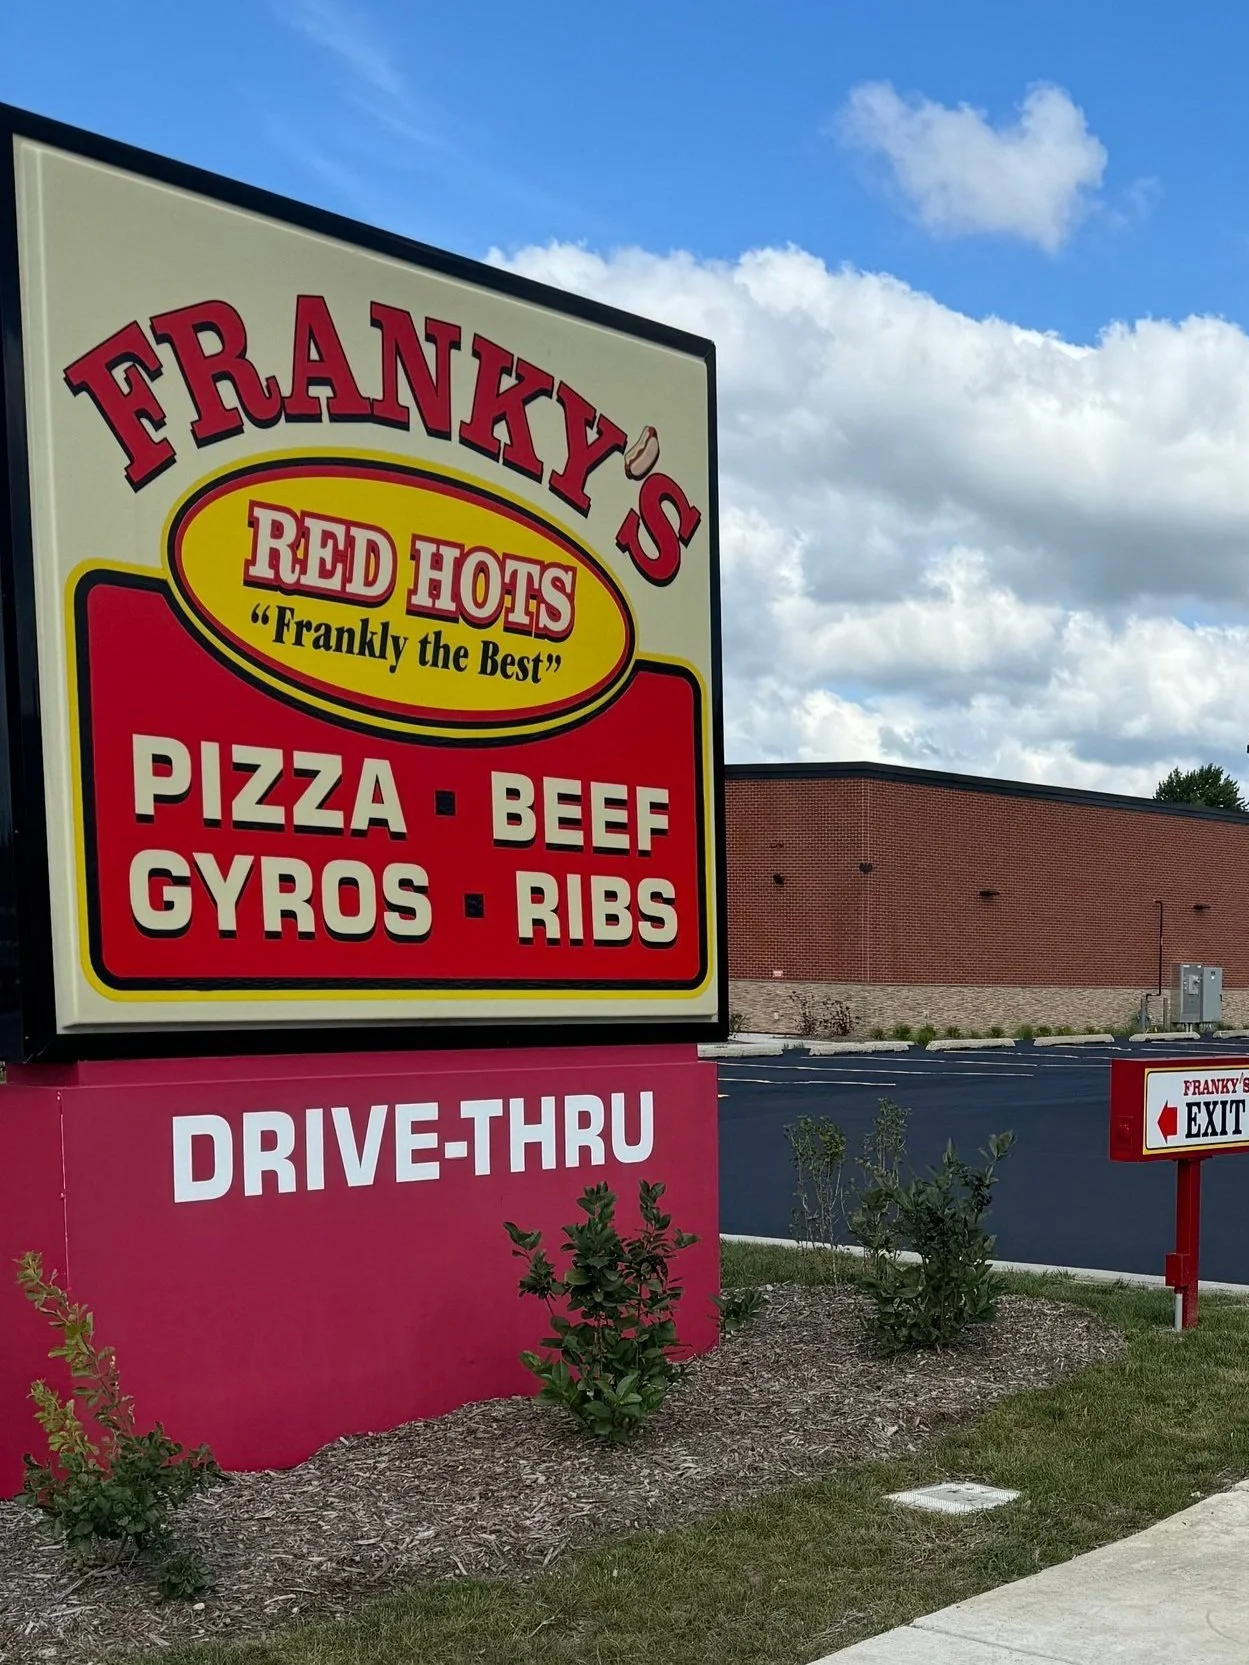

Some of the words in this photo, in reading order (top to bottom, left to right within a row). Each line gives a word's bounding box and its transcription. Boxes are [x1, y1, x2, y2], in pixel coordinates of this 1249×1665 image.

[63, 294, 700, 587] FRANKY'S
[244, 500, 397, 607] RED
[406, 533, 577, 643] HOTS
[418, 630, 468, 672] the
[132, 734, 407, 839] PIZZA
[491, 771, 670, 856] BEEF
[129, 849, 433, 942] GYROS
[516, 870, 678, 948] RIBS
[172, 1091, 654, 1203] DRIVE-THRU
[1185, 1099, 1246, 1138] EXIT
